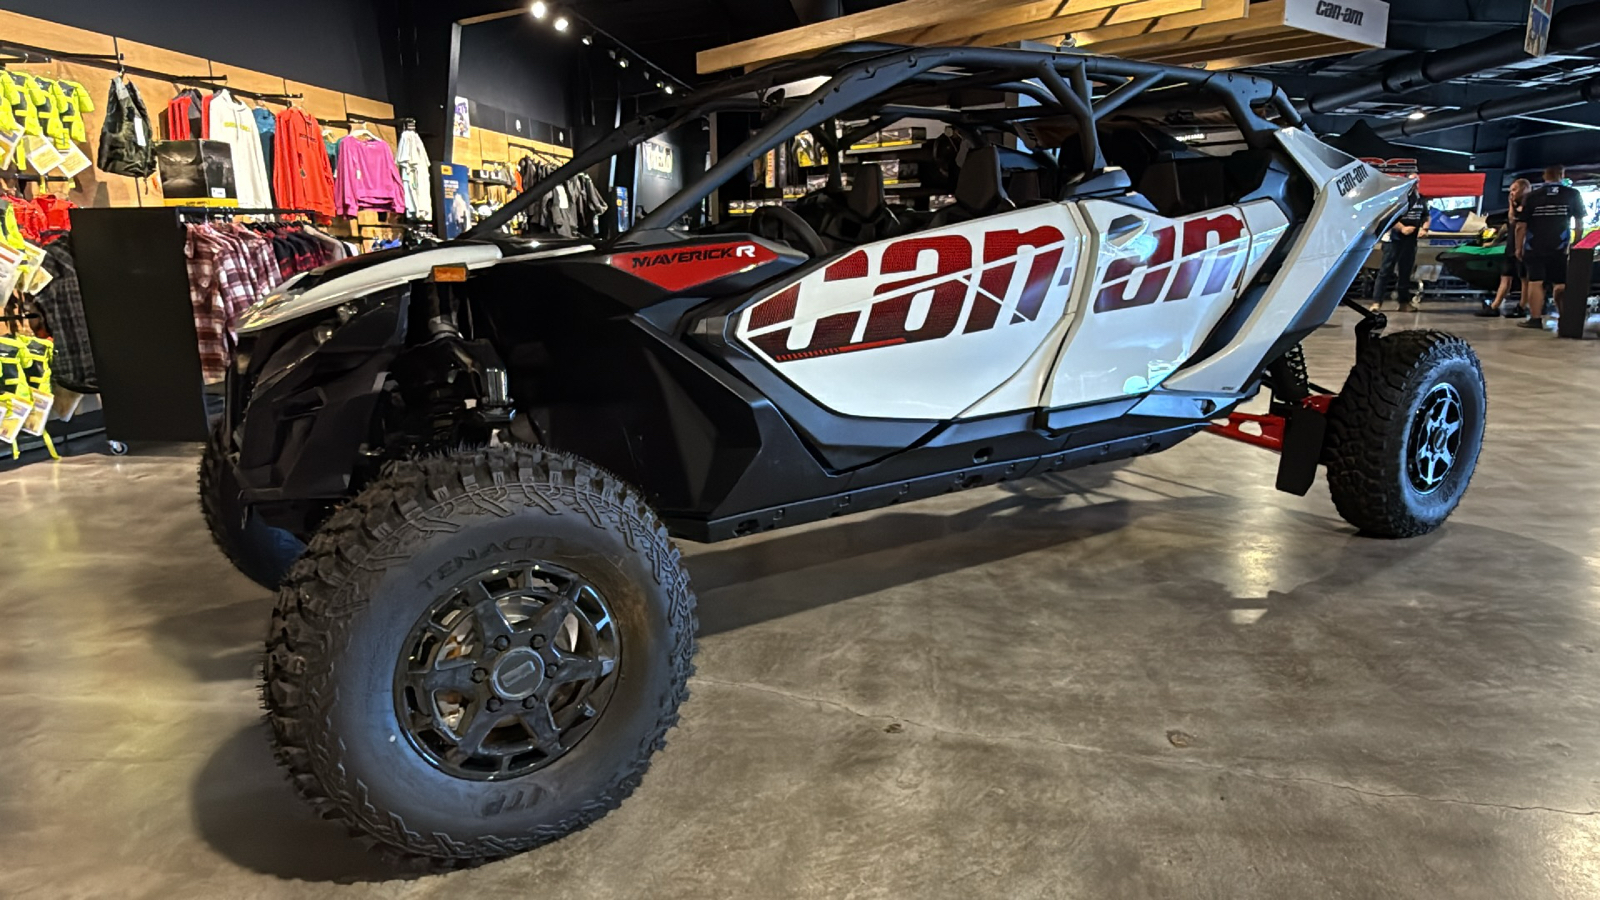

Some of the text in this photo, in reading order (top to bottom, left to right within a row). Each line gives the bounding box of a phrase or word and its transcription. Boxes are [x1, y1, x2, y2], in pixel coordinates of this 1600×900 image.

[1316, 0, 1364, 26] can-am
[1336, 164, 1369, 197] can-am
[632, 245, 756, 268] MAVERICK R
